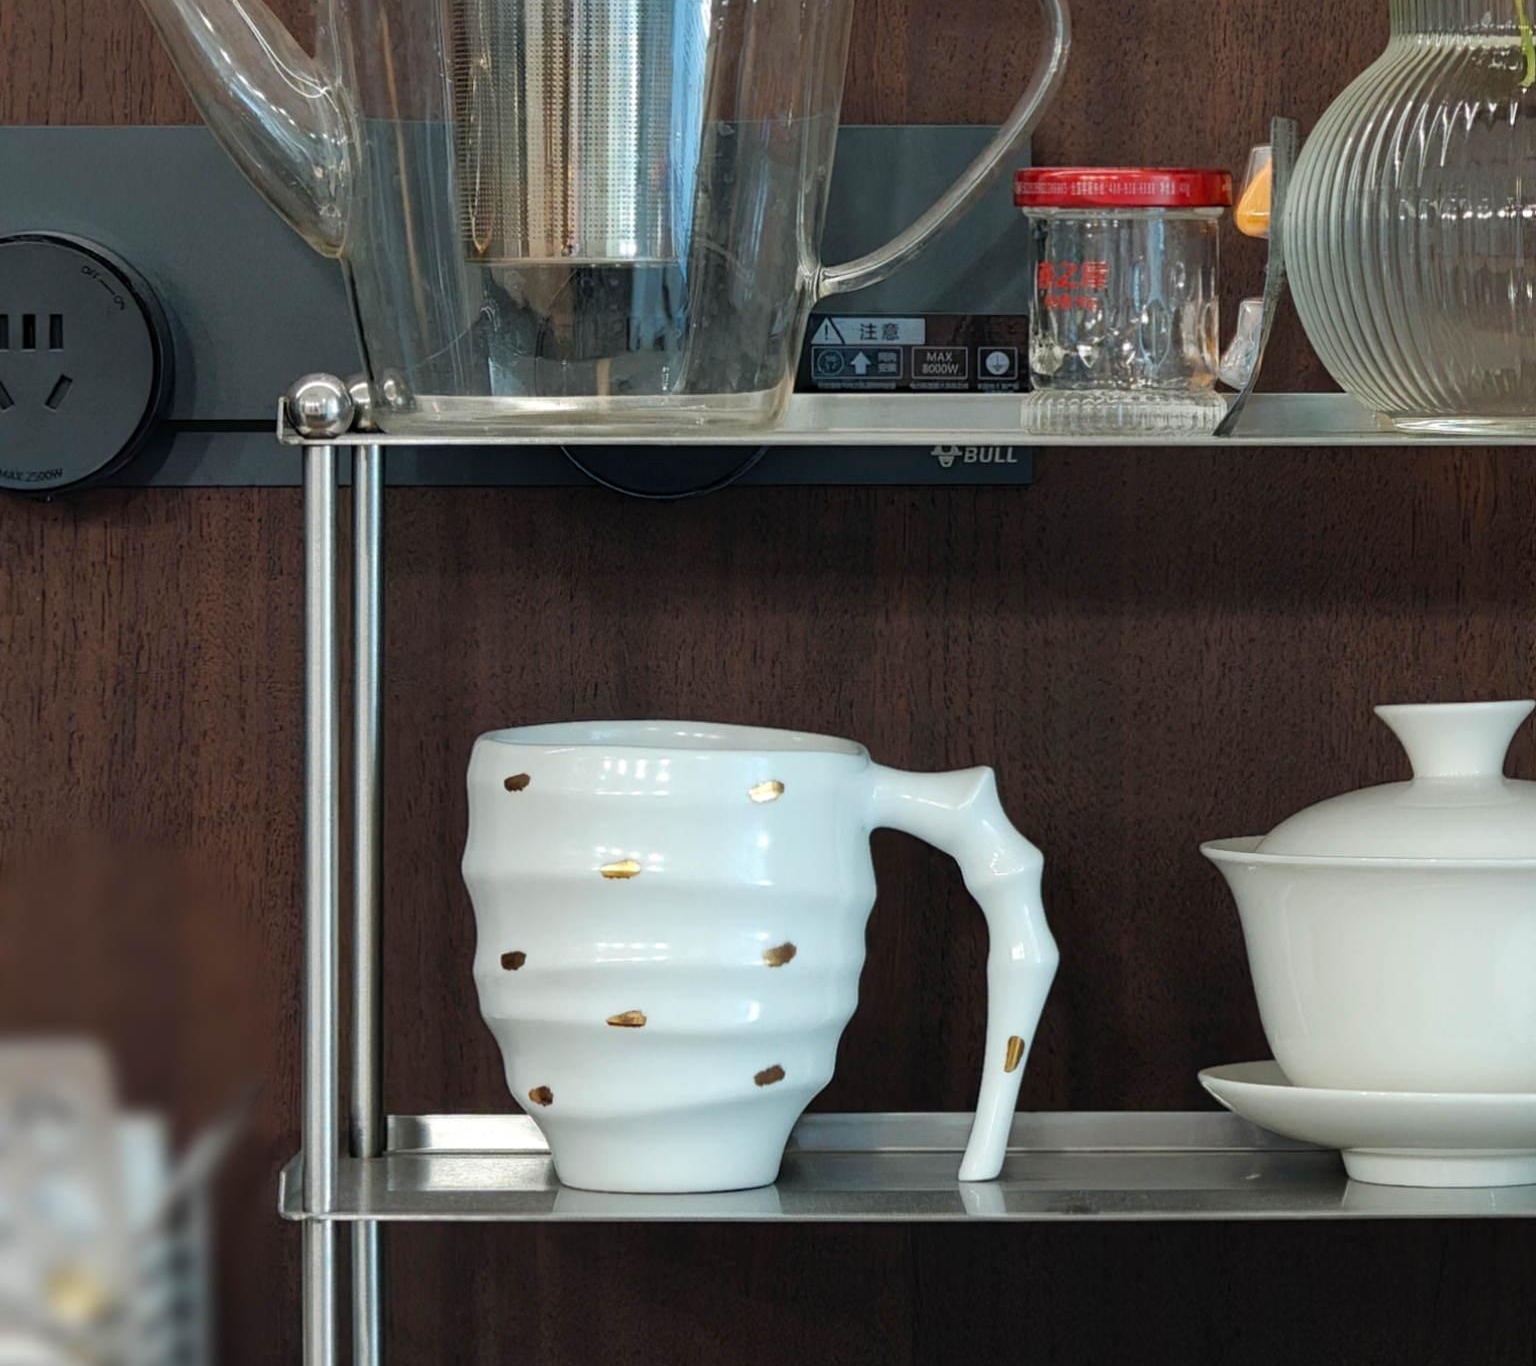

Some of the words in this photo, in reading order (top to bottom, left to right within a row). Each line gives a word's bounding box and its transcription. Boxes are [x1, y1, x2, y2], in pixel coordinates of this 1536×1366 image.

[859, 322, 900, 341] 注意
[926, 352, 953, 362] MAX
[922, 363, 959, 376] 8000W
[964, 446, 1018, 463] BULL
